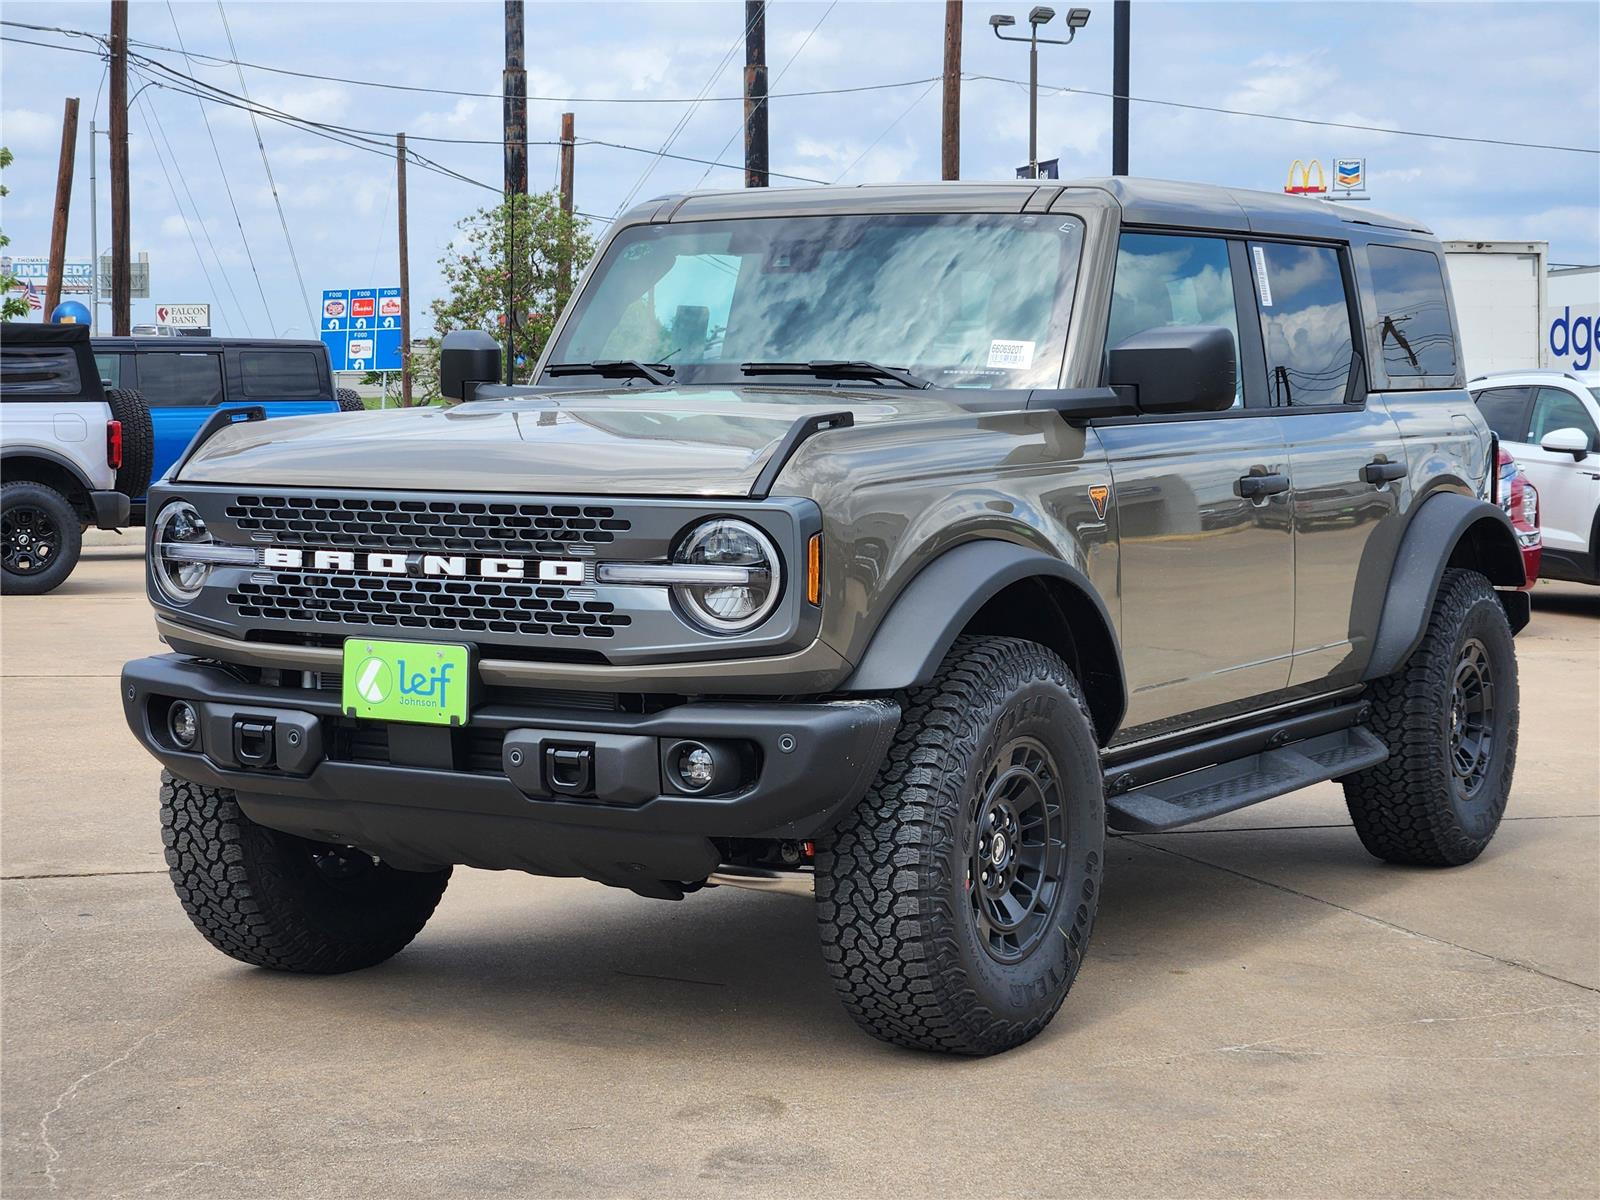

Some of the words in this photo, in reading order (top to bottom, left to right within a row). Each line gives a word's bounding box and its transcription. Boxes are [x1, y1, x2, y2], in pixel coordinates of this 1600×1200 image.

[171, 307, 207, 316] FALCON
[171, 316, 198, 324] BANK
[264, 547, 585, 582] BRONCO
[397, 659, 455, 709] leif
[399, 696, 437, 708] Johnson
